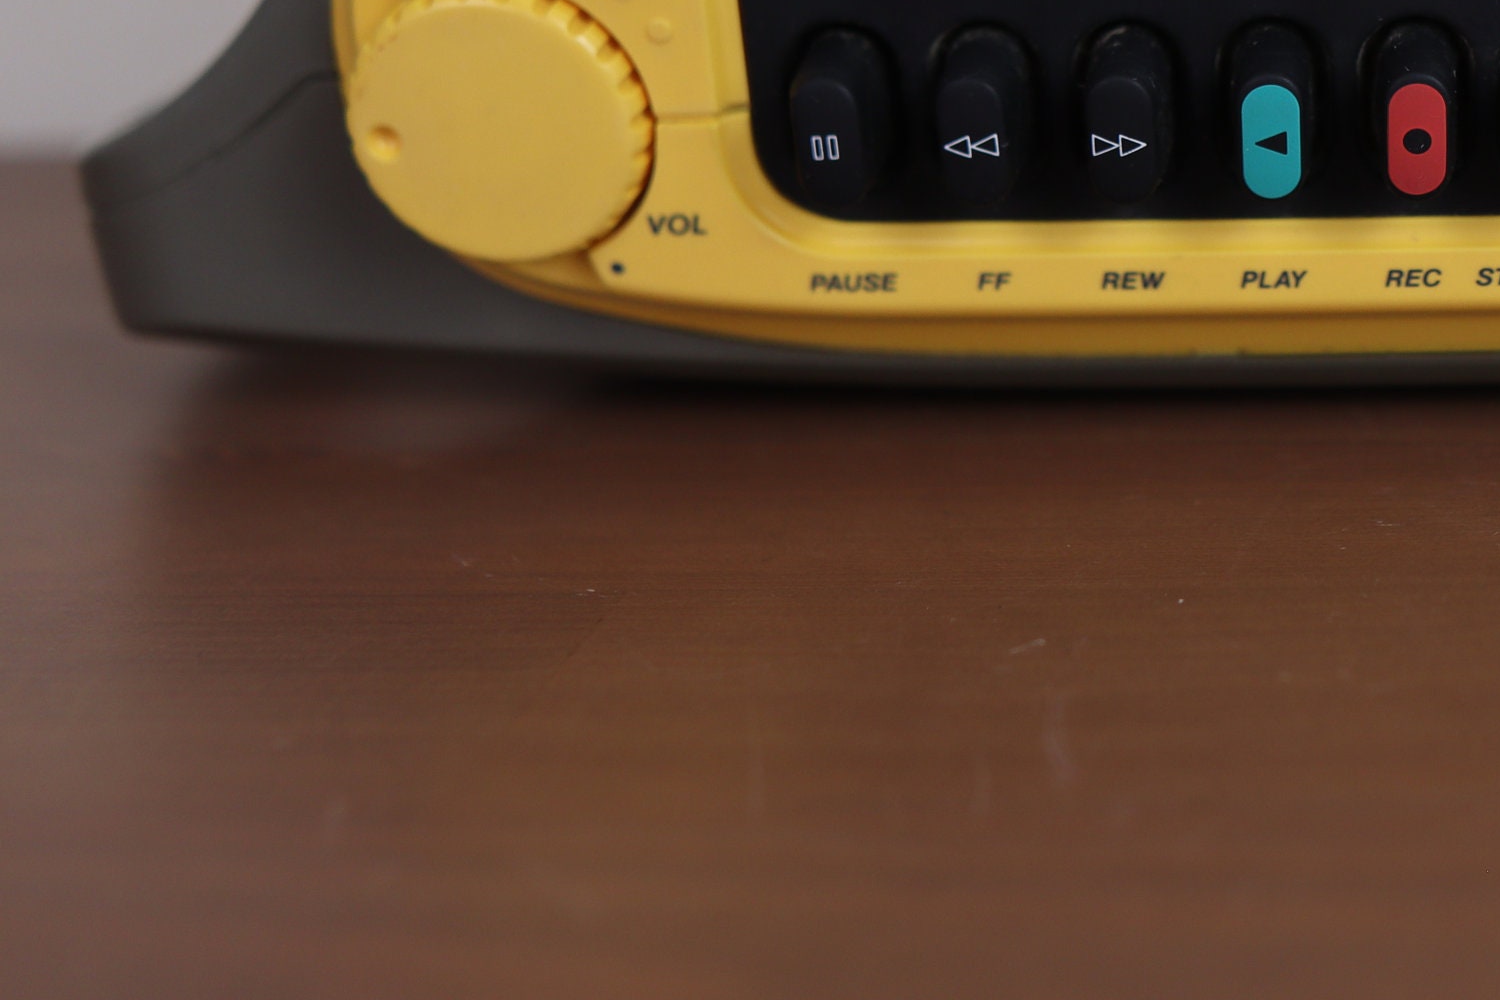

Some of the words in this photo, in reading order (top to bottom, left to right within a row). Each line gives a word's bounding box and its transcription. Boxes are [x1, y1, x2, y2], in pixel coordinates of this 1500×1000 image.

[647, 213, 708, 237] VOL
[808, 272, 899, 293] PAUSE
[976, 271, 1013, 292] FF
[1100, 271, 1167, 291] REW
[1240, 269, 1309, 290] PLAY
[1384, 267, 1443, 289] REC
